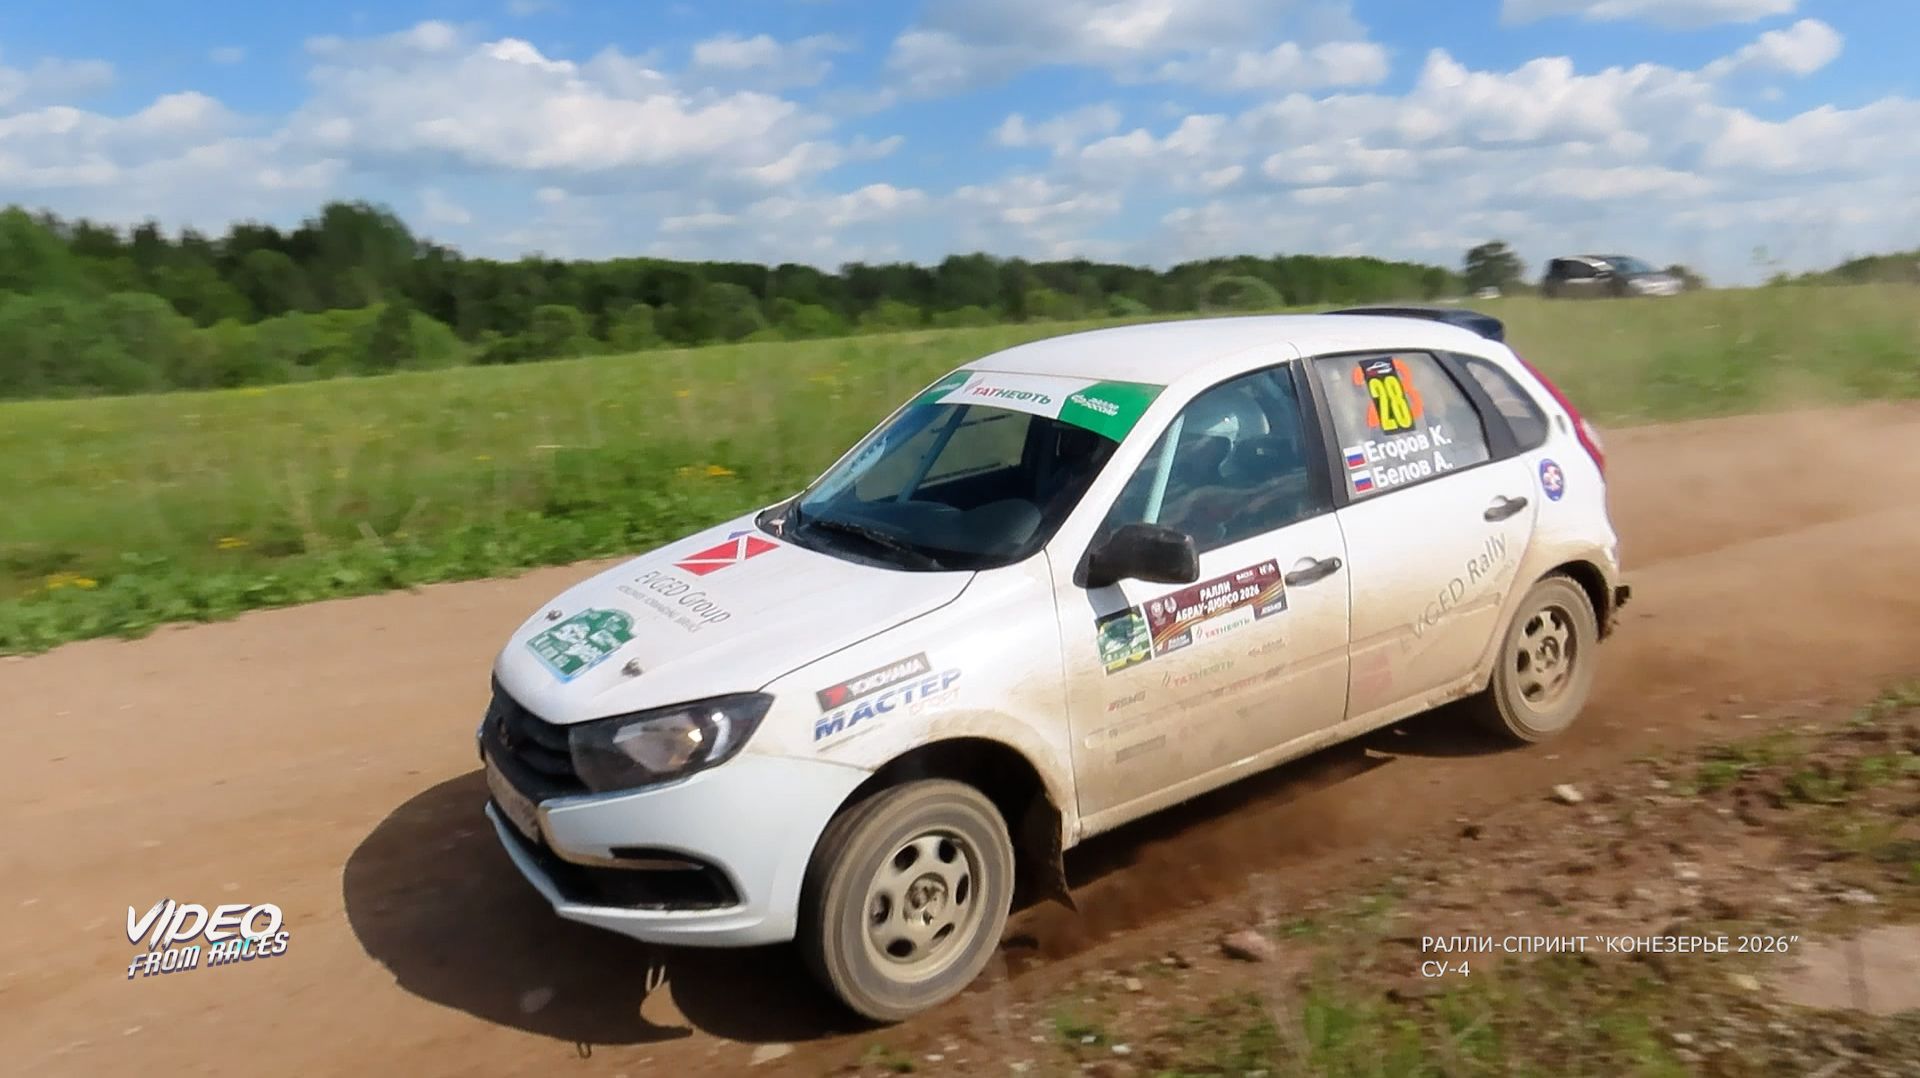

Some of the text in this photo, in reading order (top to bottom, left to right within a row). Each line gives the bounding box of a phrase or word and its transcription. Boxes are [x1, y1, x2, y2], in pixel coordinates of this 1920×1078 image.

[972, 386, 1052, 405] ТАТНЕФТЬ
[1368, 375, 1413, 431] 28
[1365, 425, 1452, 463] Егоров К.
[1373, 451, 1454, 489] Белов А.
[1466, 533, 1507, 585] Rally
[634, 570, 690, 597] EVGED
[678, 591, 732, 628] Group
[1174, 594, 1239, 623] АБРАУ-ДЮРСО
[1240, 584, 1260, 600] 2026
[1199, 581, 1232, 599] РАЛЛИ
[814, 667, 962, 742] МАСТЕР
